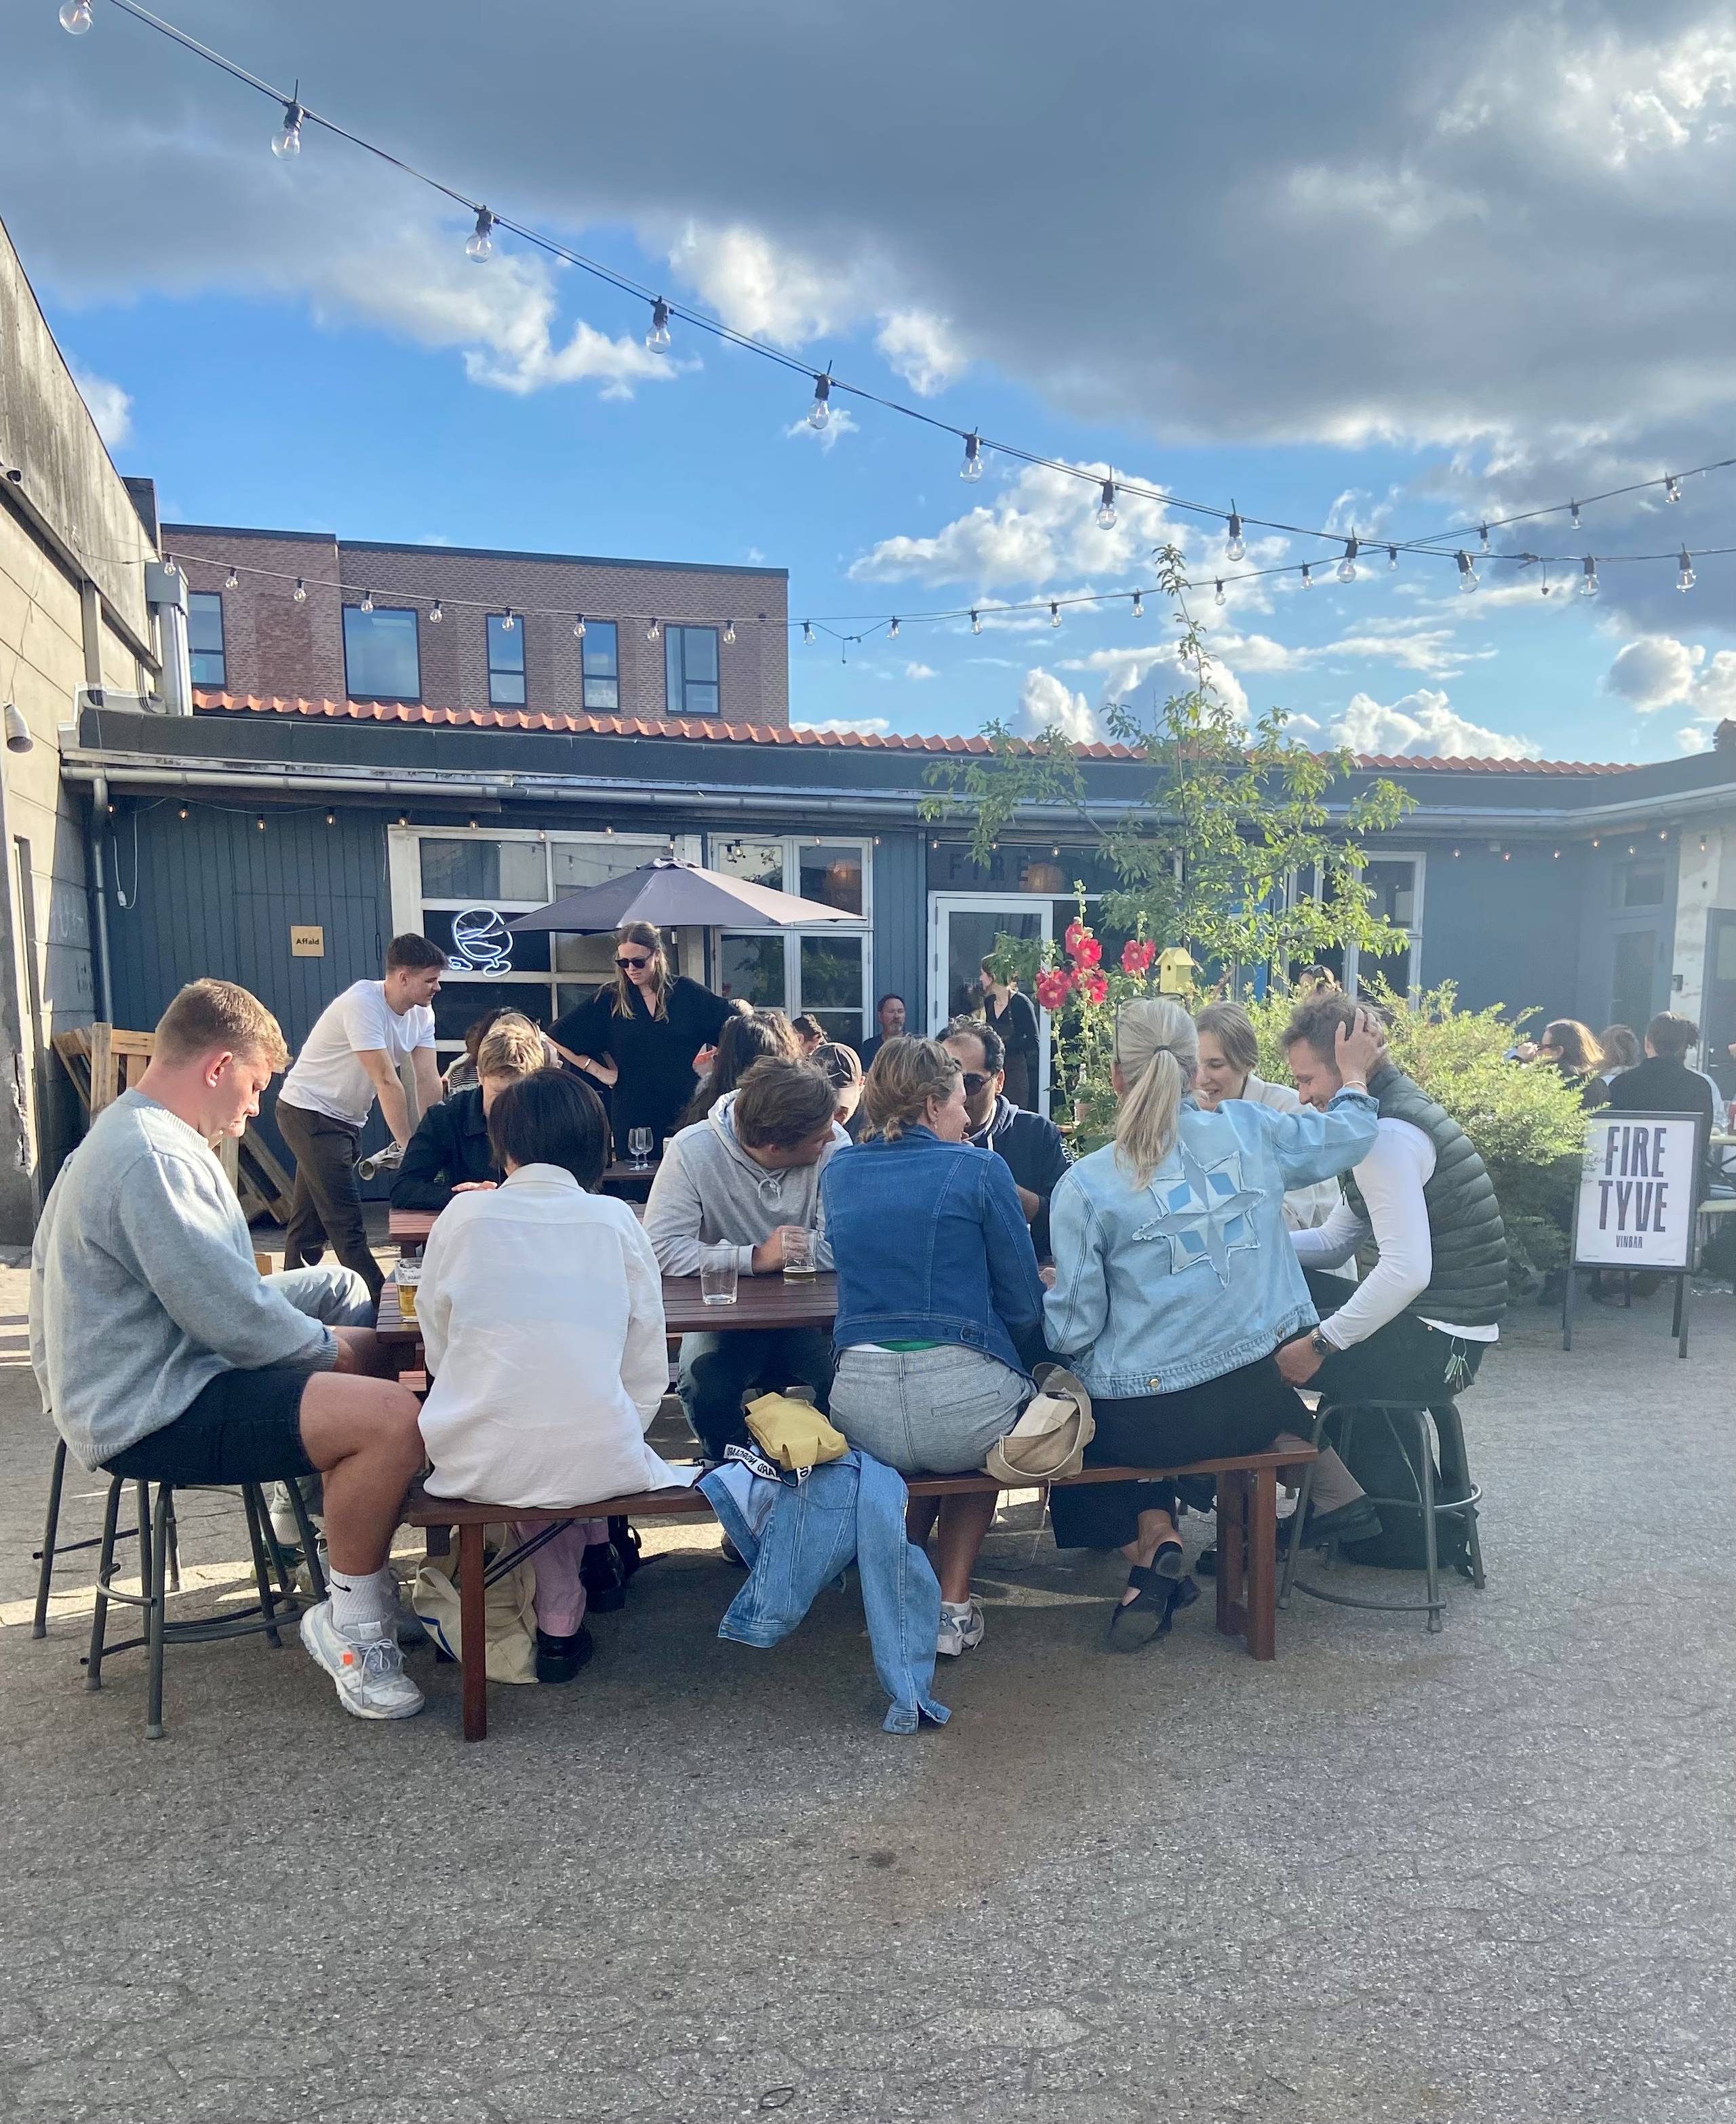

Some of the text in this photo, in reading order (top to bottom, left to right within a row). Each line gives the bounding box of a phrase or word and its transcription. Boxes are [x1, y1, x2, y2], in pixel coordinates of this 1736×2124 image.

[1605, 1126, 1667, 1177] FIRE
[1598, 1180, 1668, 1232] TYVE
[1616, 1235, 1642, 1248] VINBAR
